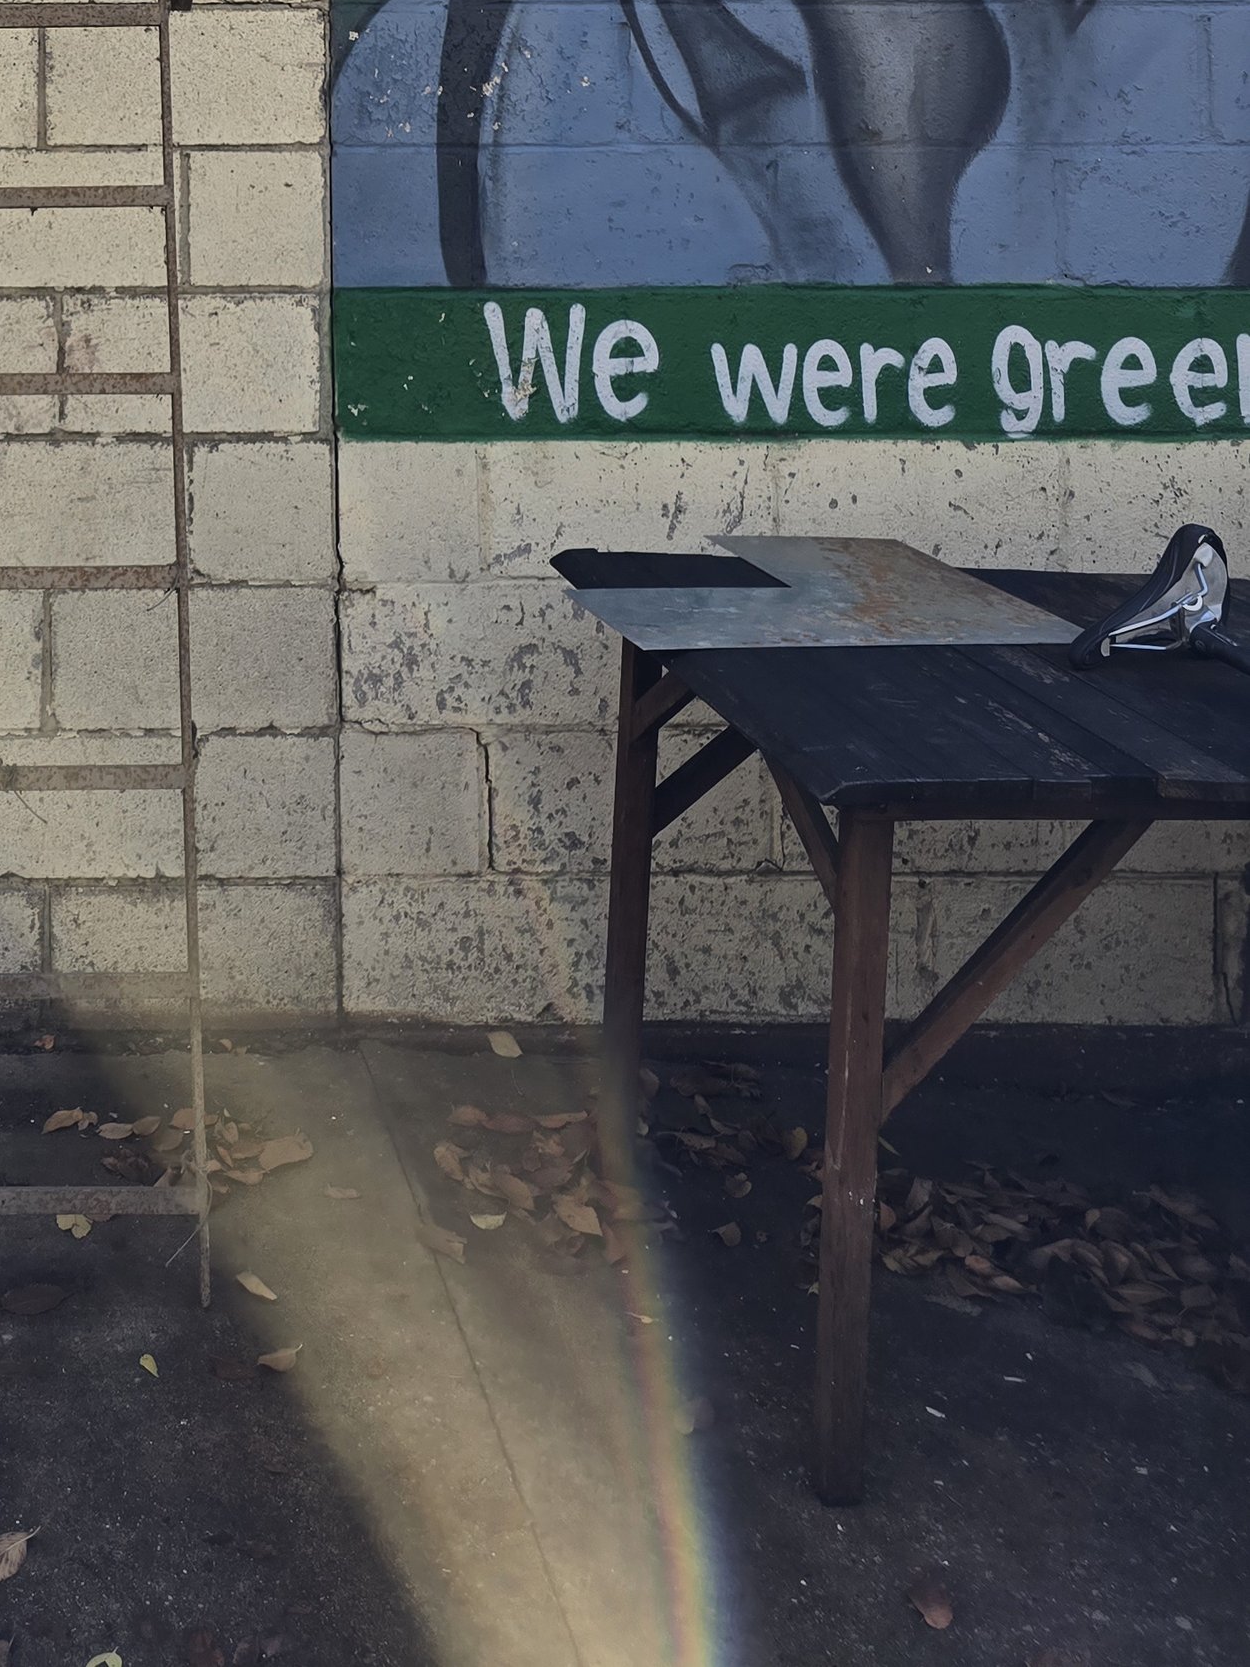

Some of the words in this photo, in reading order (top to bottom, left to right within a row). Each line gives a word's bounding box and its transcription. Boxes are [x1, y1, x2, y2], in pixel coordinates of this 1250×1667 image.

[482, 301, 660, 424] We
[710, 337, 959, 428] were
[990, 324, 1250, 439] gree
